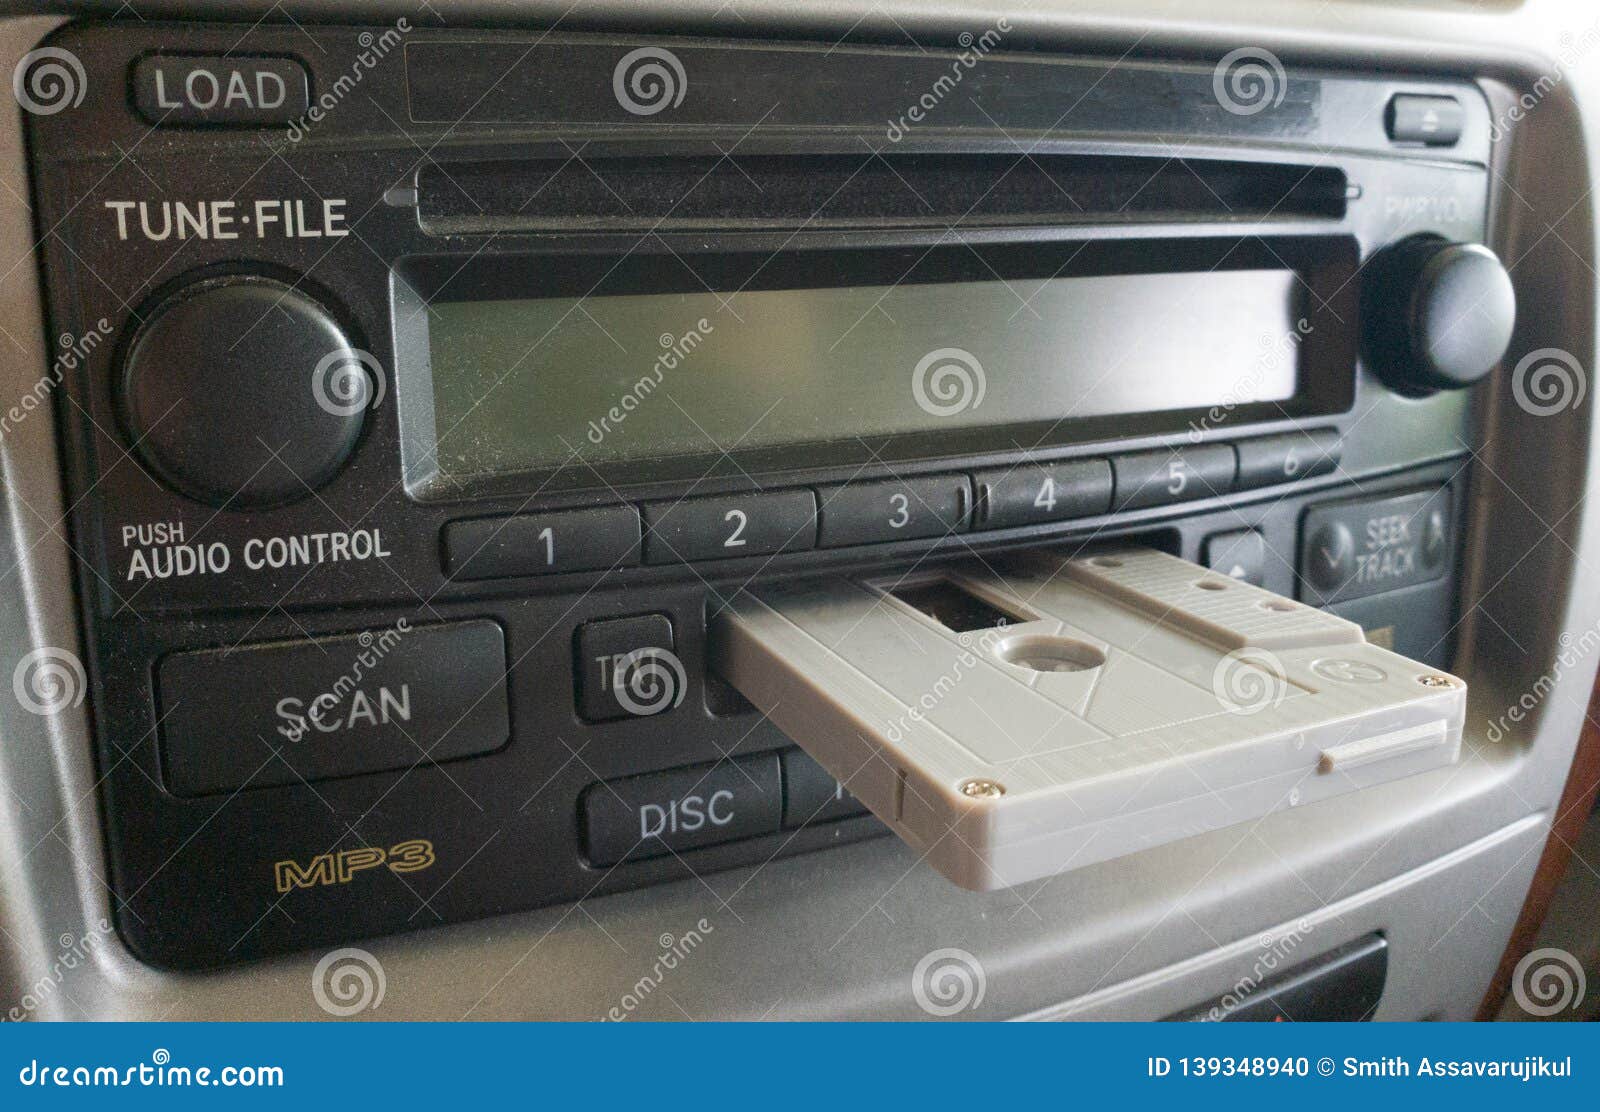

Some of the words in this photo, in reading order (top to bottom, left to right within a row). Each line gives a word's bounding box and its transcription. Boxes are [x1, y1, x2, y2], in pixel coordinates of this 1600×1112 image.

[154, 69, 287, 110] LOAD
[1168, 459, 1188, 495] 5
[1283, 451, 1299, 477] 6
[888, 493, 910, 529] 3
[1034, 478, 1057, 512] 4
[122, 522, 184, 547] PUSH
[538, 527, 554, 565] 1
[723, 509, 747, 547] 2
[1365, 514, 1410, 550] SEEK
[127, 541, 231, 581] AUDIO
[243, 528, 391, 569] CONTROL
[1356, 549, 1416, 583] TRACK
[275, 683, 412, 735] SCAN
[640, 790, 735, 838] DISC
[274, 839, 436, 893] MP3
